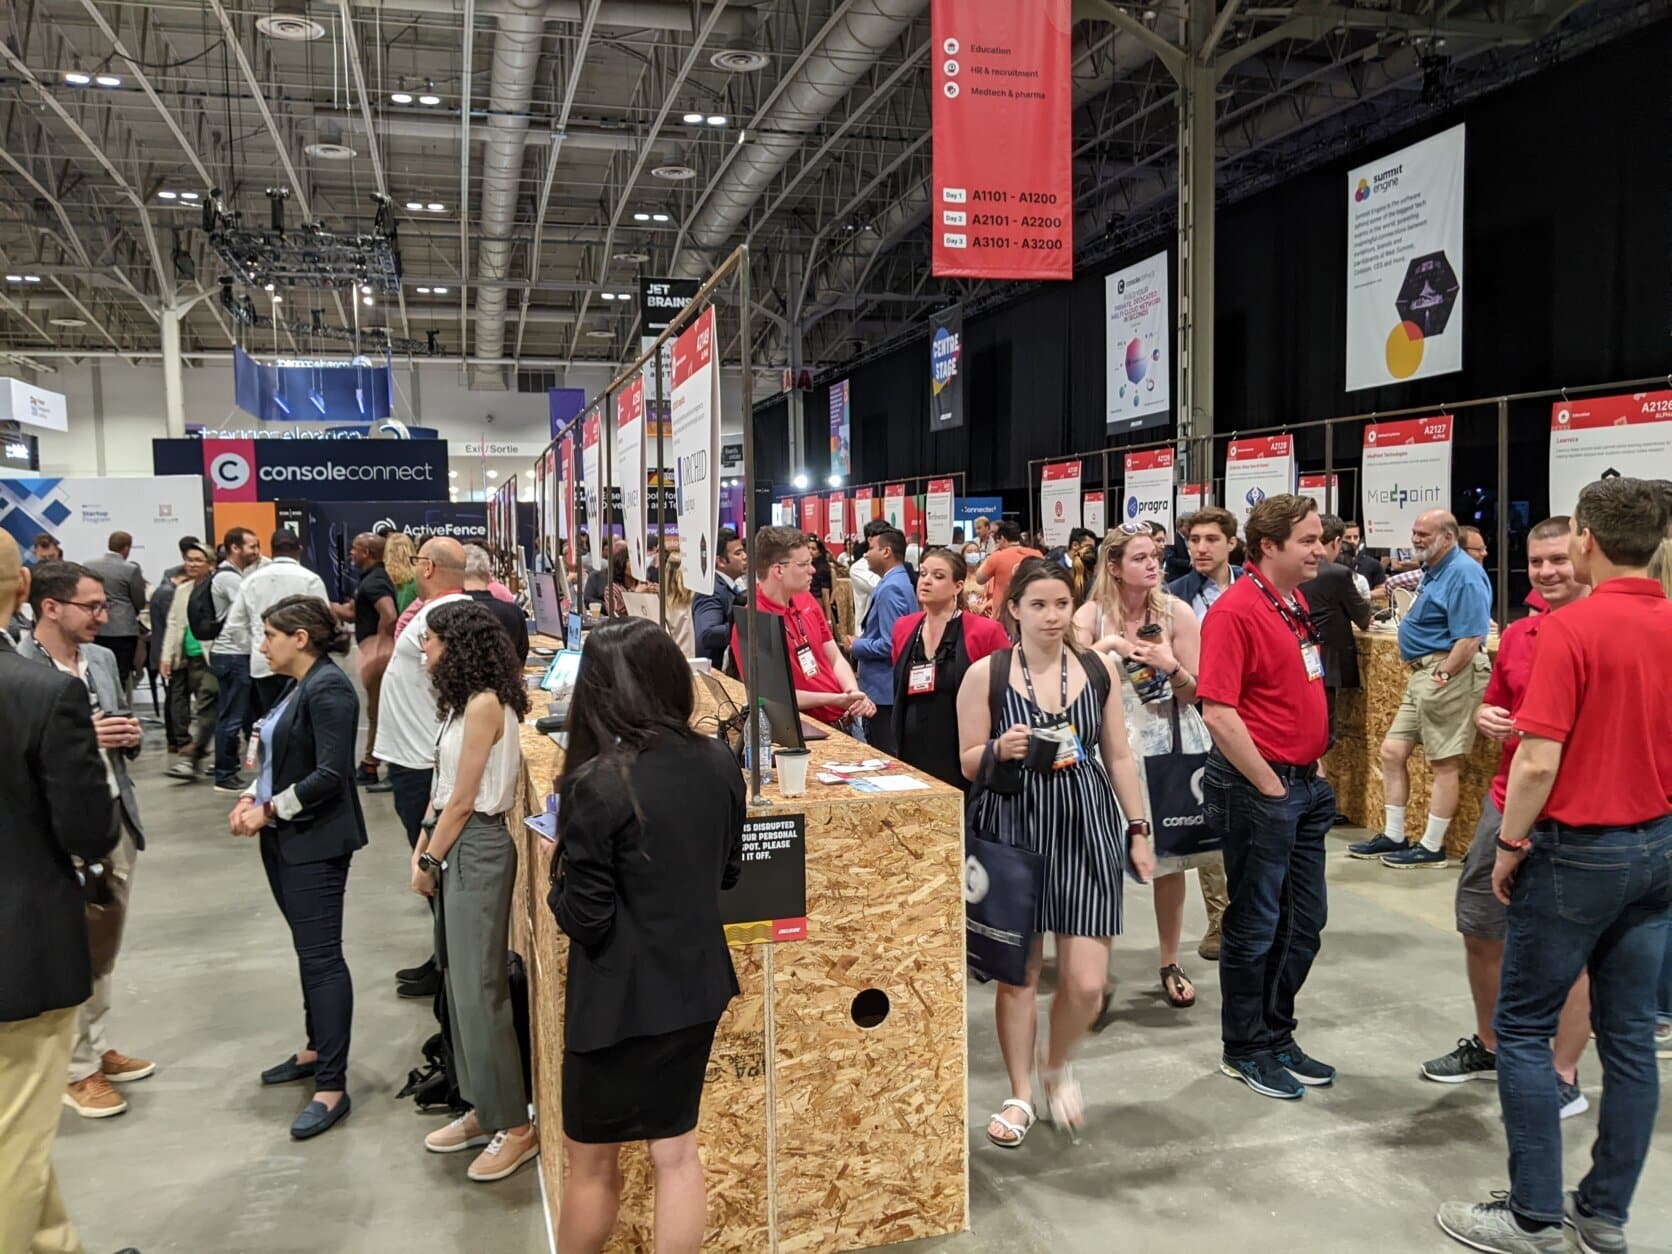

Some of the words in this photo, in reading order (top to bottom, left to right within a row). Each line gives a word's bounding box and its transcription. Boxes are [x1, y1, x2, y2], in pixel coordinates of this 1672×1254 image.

[971, 45, 1011, 55] Education
[971, 66, 982, 75] HR
[985, 67, 990, 75] &
[992, 68, 1039, 78] recruitment
[971, 87, 1006, 97] Medtech
[1008, 90, 1013, 98] &
[1015, 91, 1045, 100] pharma
[1373, 164, 1402, 182] summit
[1373, 177, 1399, 193] engine
[946, 191, 957, 201] Day
[972, 190, 1007, 203] A1101
[1019, 192, 1057, 204] A1200
[946, 215, 957, 224] Day
[972, 214, 1009, 227] A2101
[1021, 216, 1061, 228] A2200
[946, 236, 957, 246] Day
[972, 236, 1010, 249] A3101
[1021, 238, 1062, 250] A3200
[647, 283, 670, 295] JET
[933, 333, 960, 358] CENTRE
[935, 357, 957, 379] STAGE
[1641, 400, 1672, 413] A2126
[1424, 424, 1447, 435] A2127
[259, 461, 433, 481] consoleconnect
[1138, 499, 1169, 515] pragra
[403, 523, 486, 537] ActiveFence
[753, 821, 795, 831] DISRUPTED
[758, 829, 797, 841] PERSONAL
[762, 840, 791, 850] PLEASE
[746, 852, 754, 861] IT
[755, 851, 771, 860] OFF.
